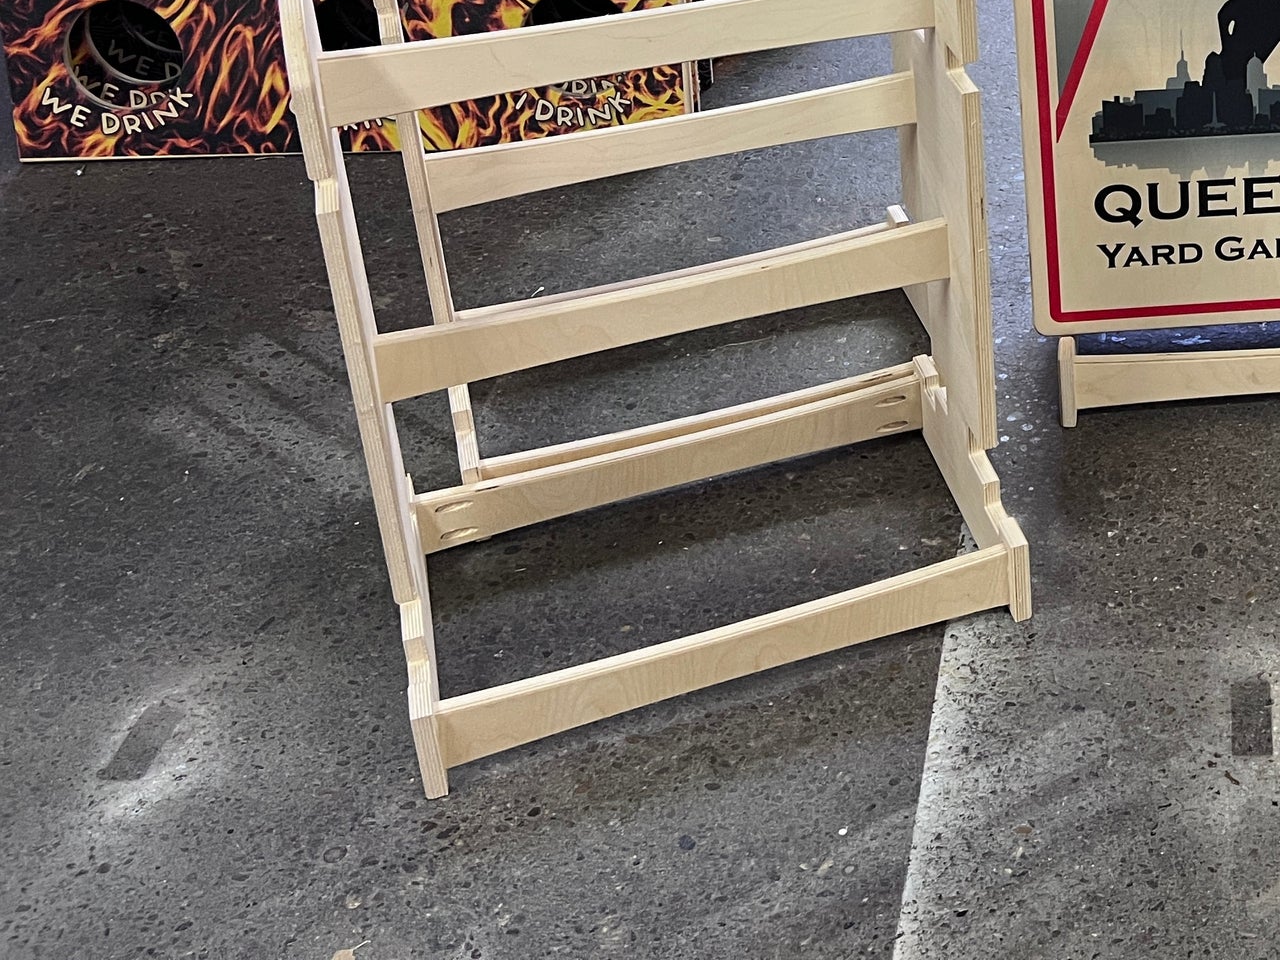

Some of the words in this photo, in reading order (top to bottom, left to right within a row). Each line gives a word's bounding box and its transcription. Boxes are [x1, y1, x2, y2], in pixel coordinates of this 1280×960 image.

[42, 87, 92, 127] WE
[101, 87, 194, 135] DRINK
[516, 93, 527, 110] I
[535, 92, 631, 127] DRINK
